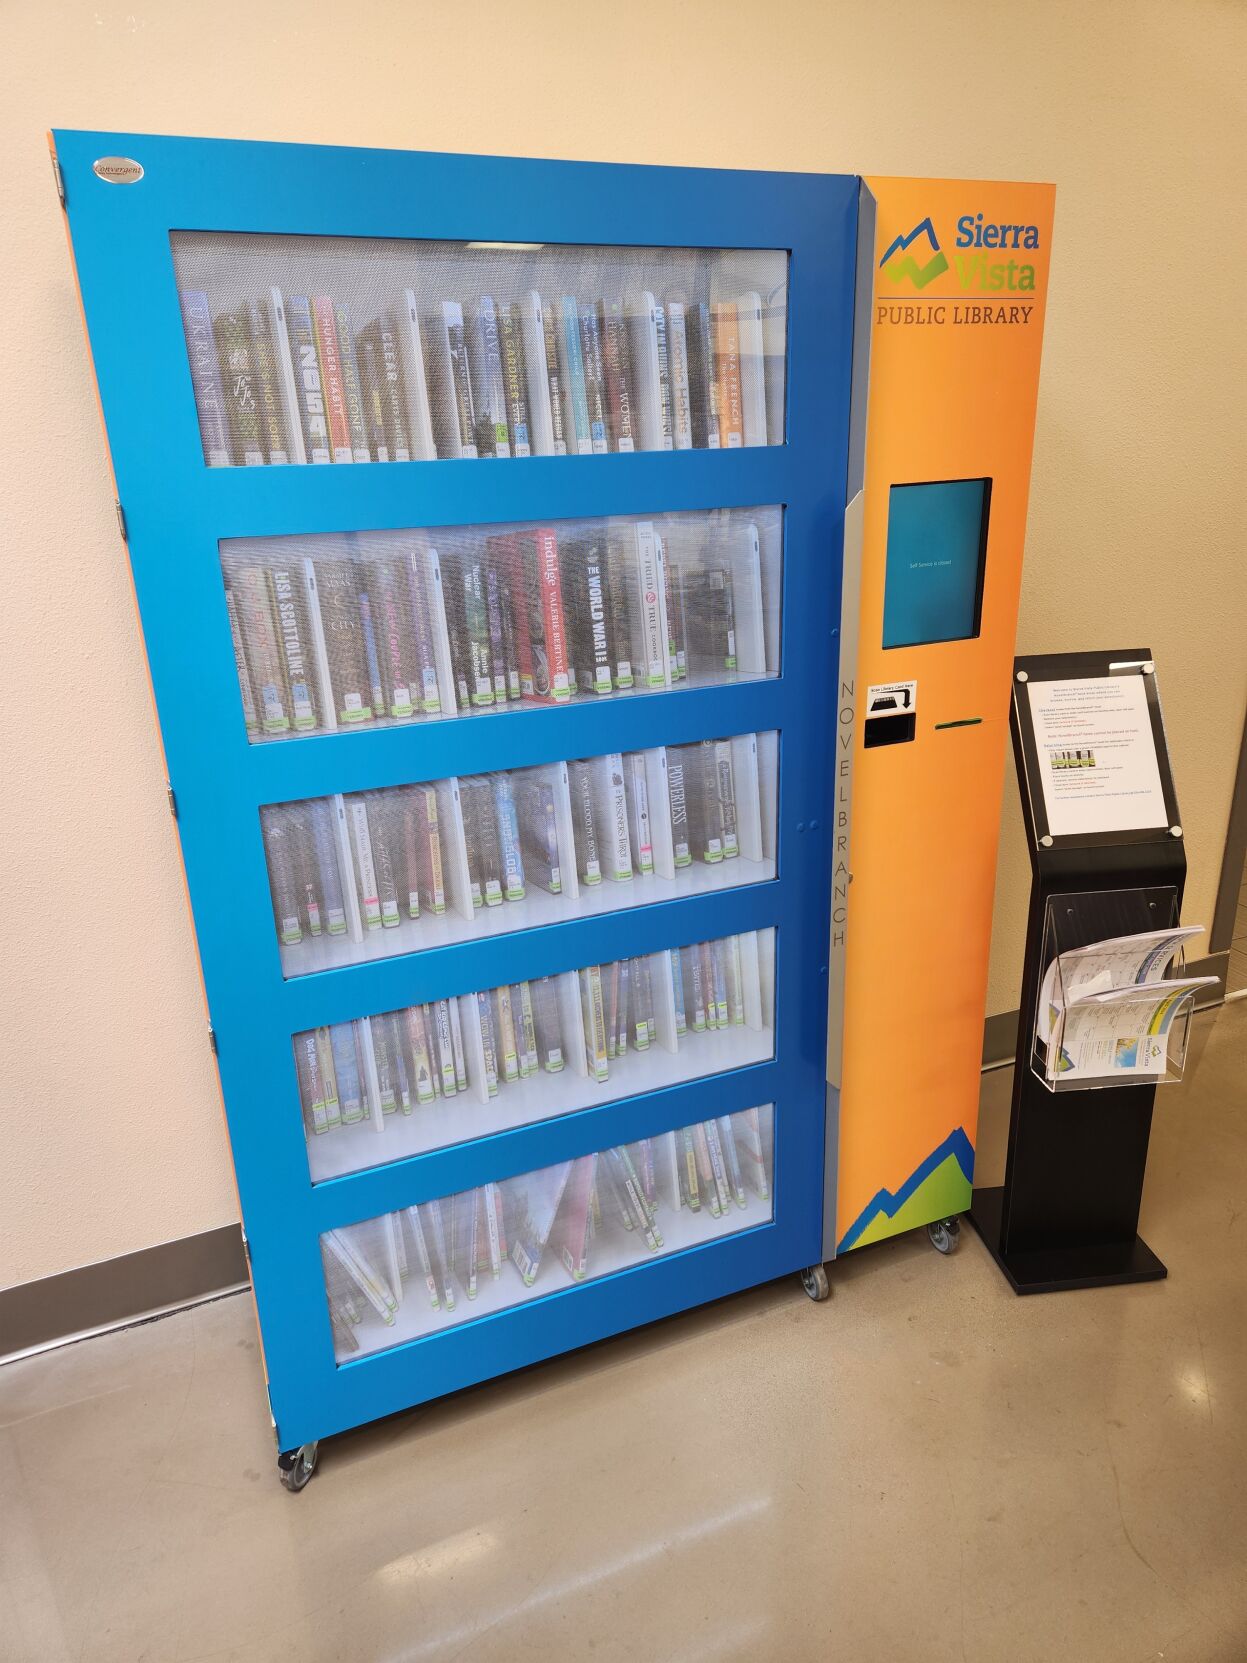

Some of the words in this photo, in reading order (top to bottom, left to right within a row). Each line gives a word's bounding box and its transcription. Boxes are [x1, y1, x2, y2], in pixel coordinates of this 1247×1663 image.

[956, 213, 1039, 249] Sierra
[953, 251, 1035, 290] Vista
[484, 310, 500, 362] DRIVE
[501, 304, 513, 334] LISA
[877, 306, 945, 324] PUBLIC
[953, 306, 1033, 324] LIBRARY
[190, 306, 217, 409] UKRAINE
[322, 318, 337, 371] HUNGER
[330, 377, 343, 414] HABIT
[382, 332, 397, 381] CLEAR
[505, 339, 519, 399] GARDNER
[675, 388, 689, 434] Habits
[729, 377, 740, 425] FRENCH
[464, 573, 472, 592] War
[472, 565, 482, 600] Nuclear
[544, 536, 557, 586] indulge
[275, 571, 291, 599] LISA
[588, 576, 604, 621] WORLD
[549, 591, 562, 631] VALERIE
[648, 605, 658, 633] TRUE
[279, 603, 304, 676] SCOTTOLINE
[553, 632, 564, 675] BERTINE
[593, 622, 607, 650] WAR
[668, 765, 687, 825] POWERLESS
[501, 814, 516, 874] SNOWGLOB
[306, 1038, 316, 1053] DOG
